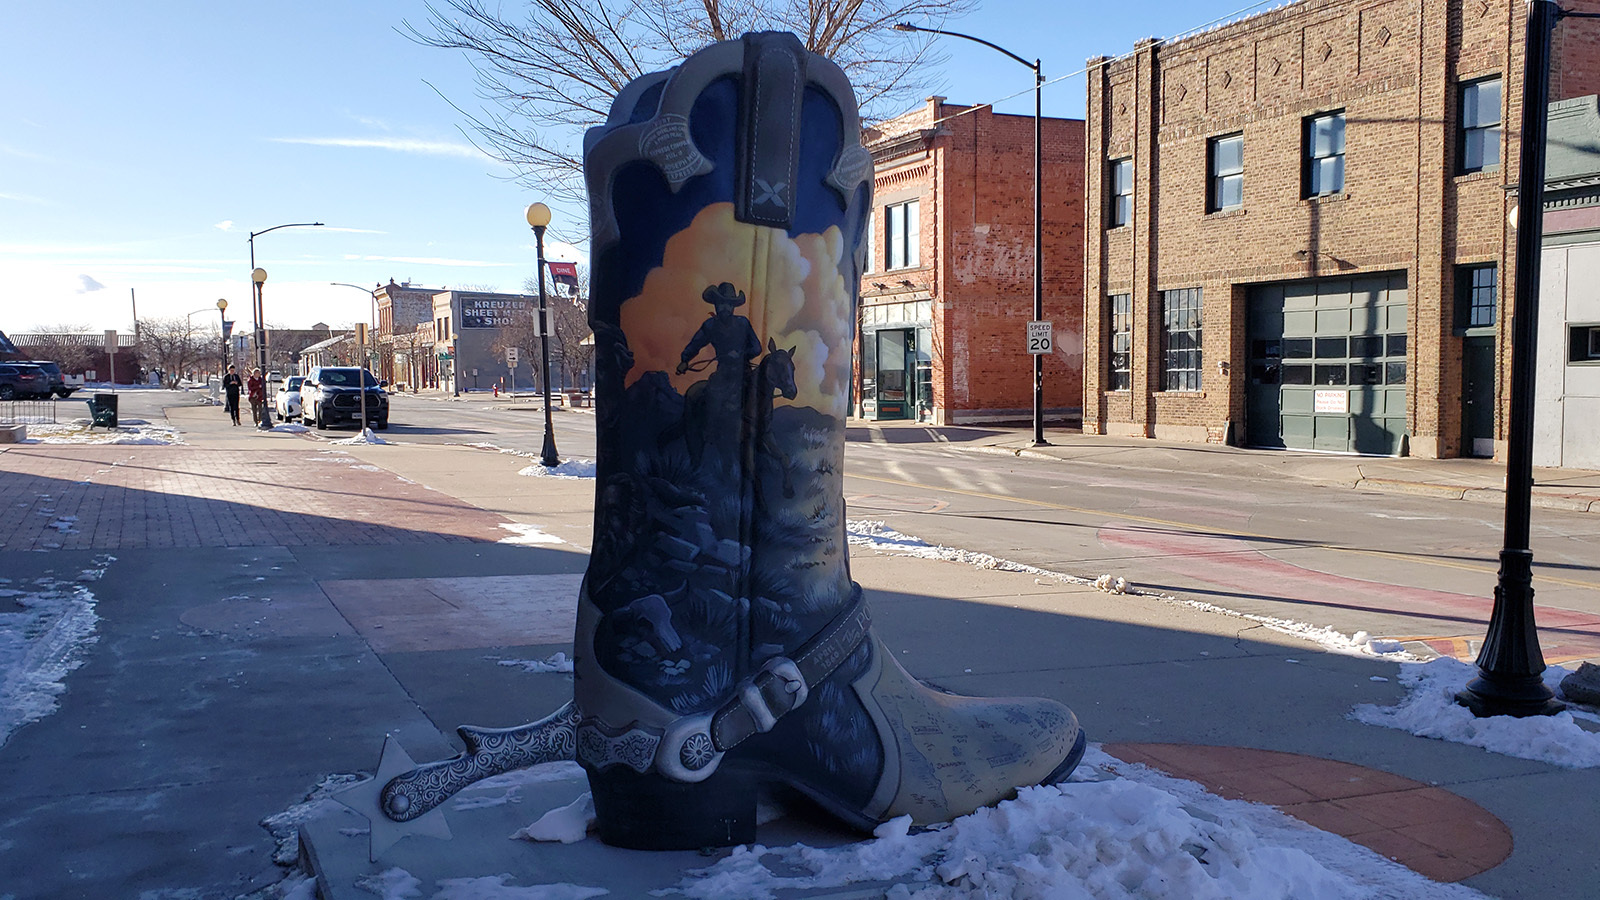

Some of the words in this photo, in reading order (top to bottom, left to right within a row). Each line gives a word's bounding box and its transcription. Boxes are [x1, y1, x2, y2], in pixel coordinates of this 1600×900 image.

[474, 301, 526, 309] KREUZER
[465, 309, 499, 317] SHEET
[1030, 338, 1050, 350] 20
